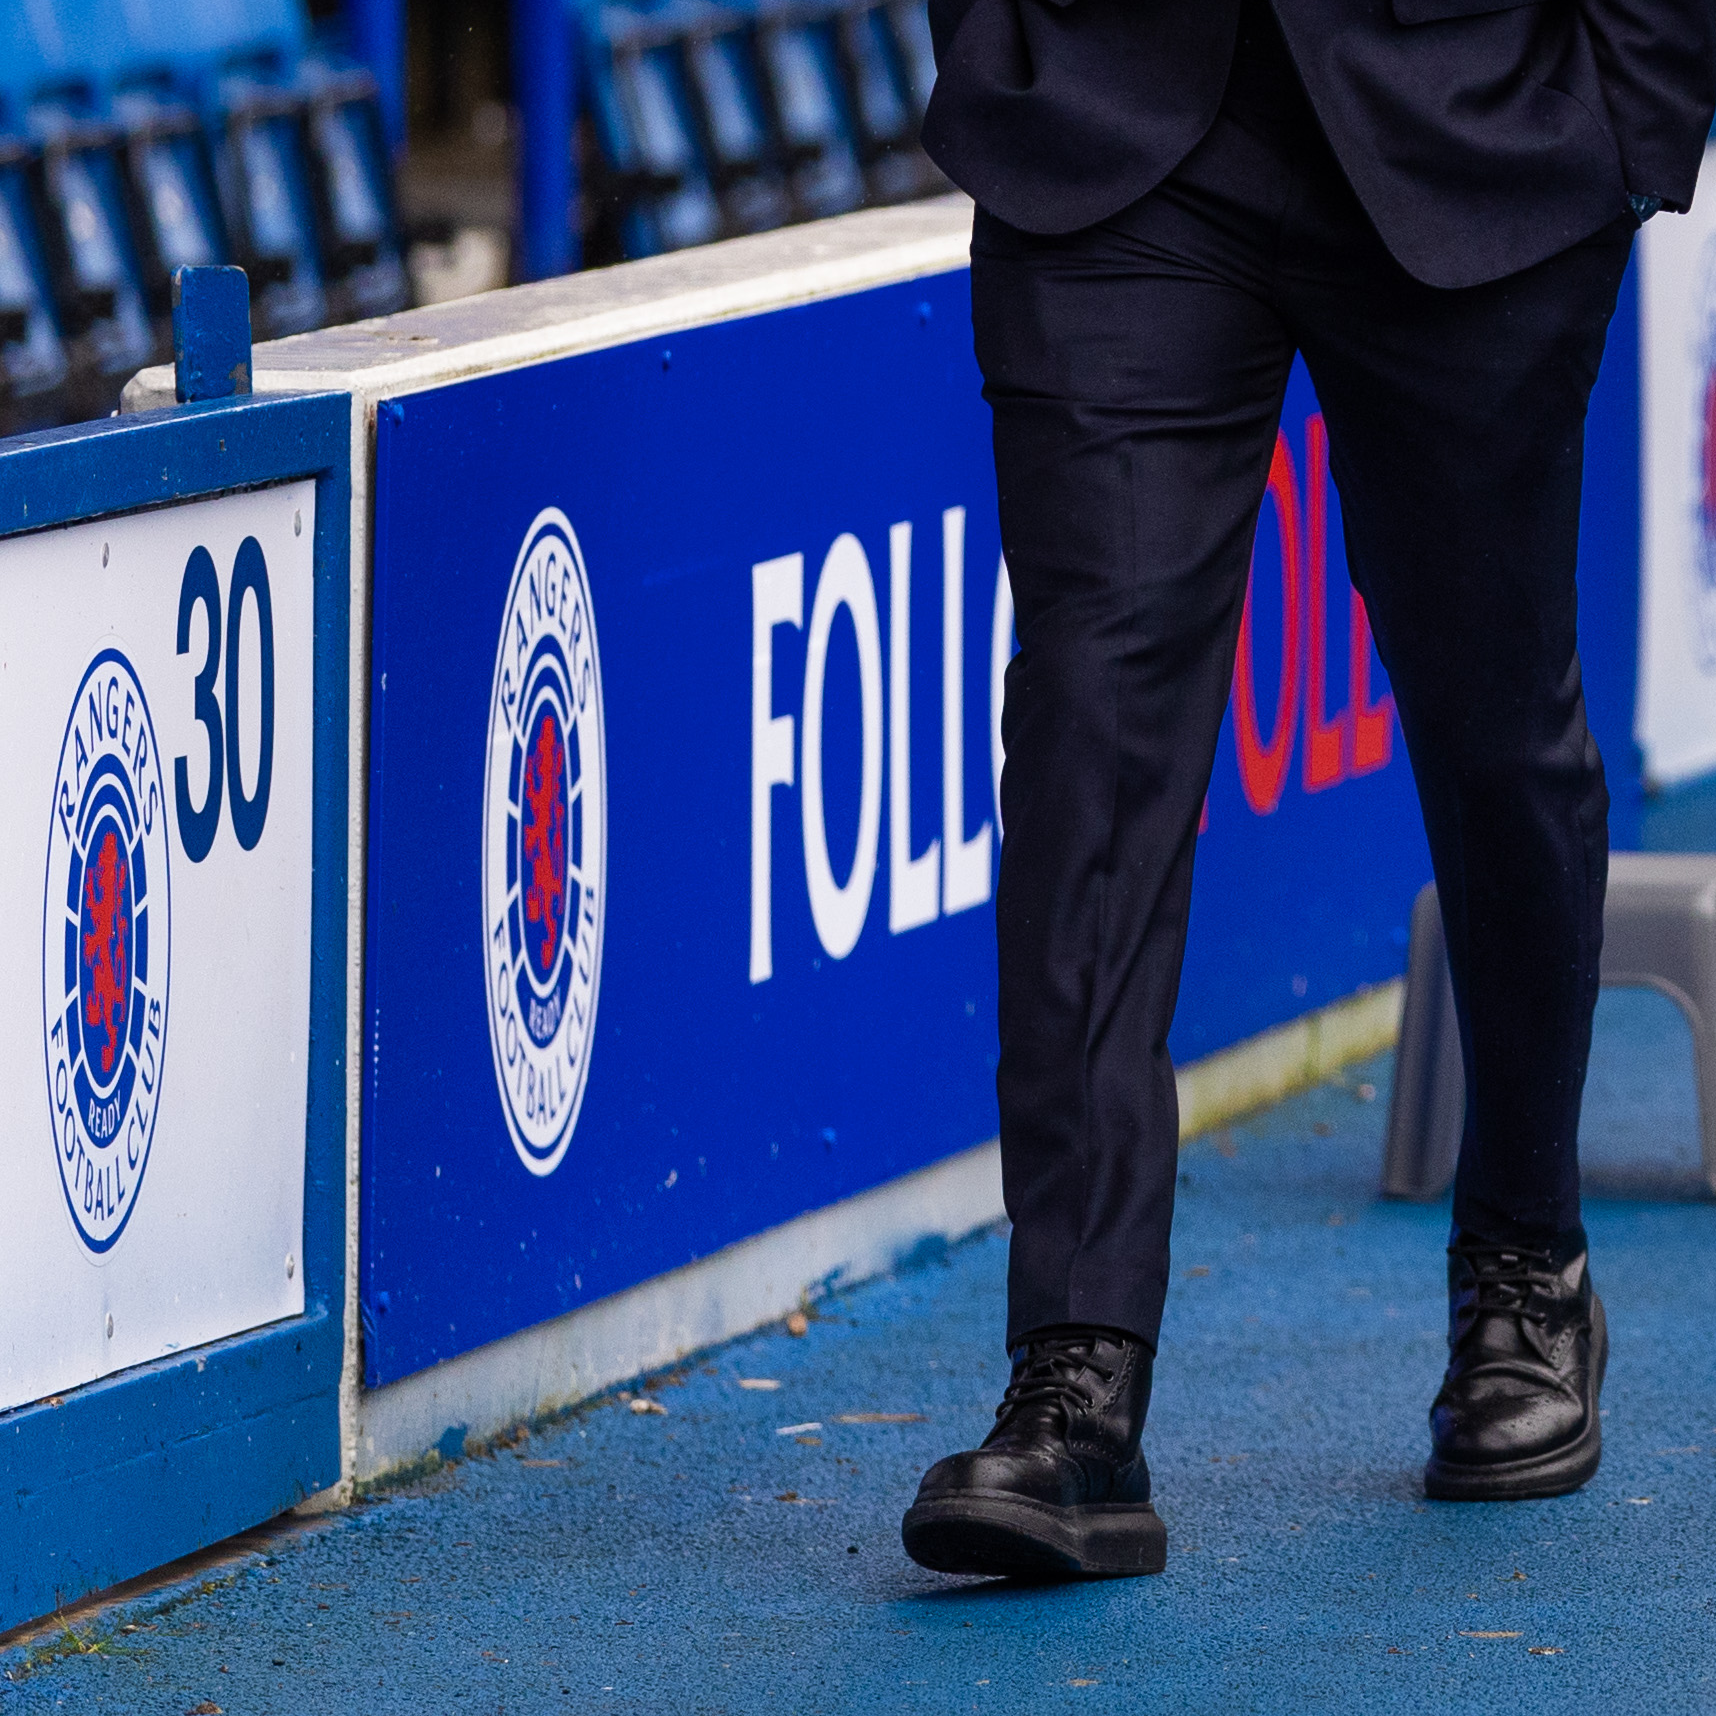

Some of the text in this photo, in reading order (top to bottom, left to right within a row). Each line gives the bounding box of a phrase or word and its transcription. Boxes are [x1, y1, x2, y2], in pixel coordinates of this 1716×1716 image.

[174, 535, 275, 864] 30
[500, 552, 593, 730] RANGERS
[749, 505, 1015, 986] FOLL
[57, 675, 159, 839] RANGERS
[50, 996, 162, 1222] FOOTBALL CLUB
[87, 1089, 122, 1140] READY
[493, 886, 596, 1127] FOOTBALL CLUB
